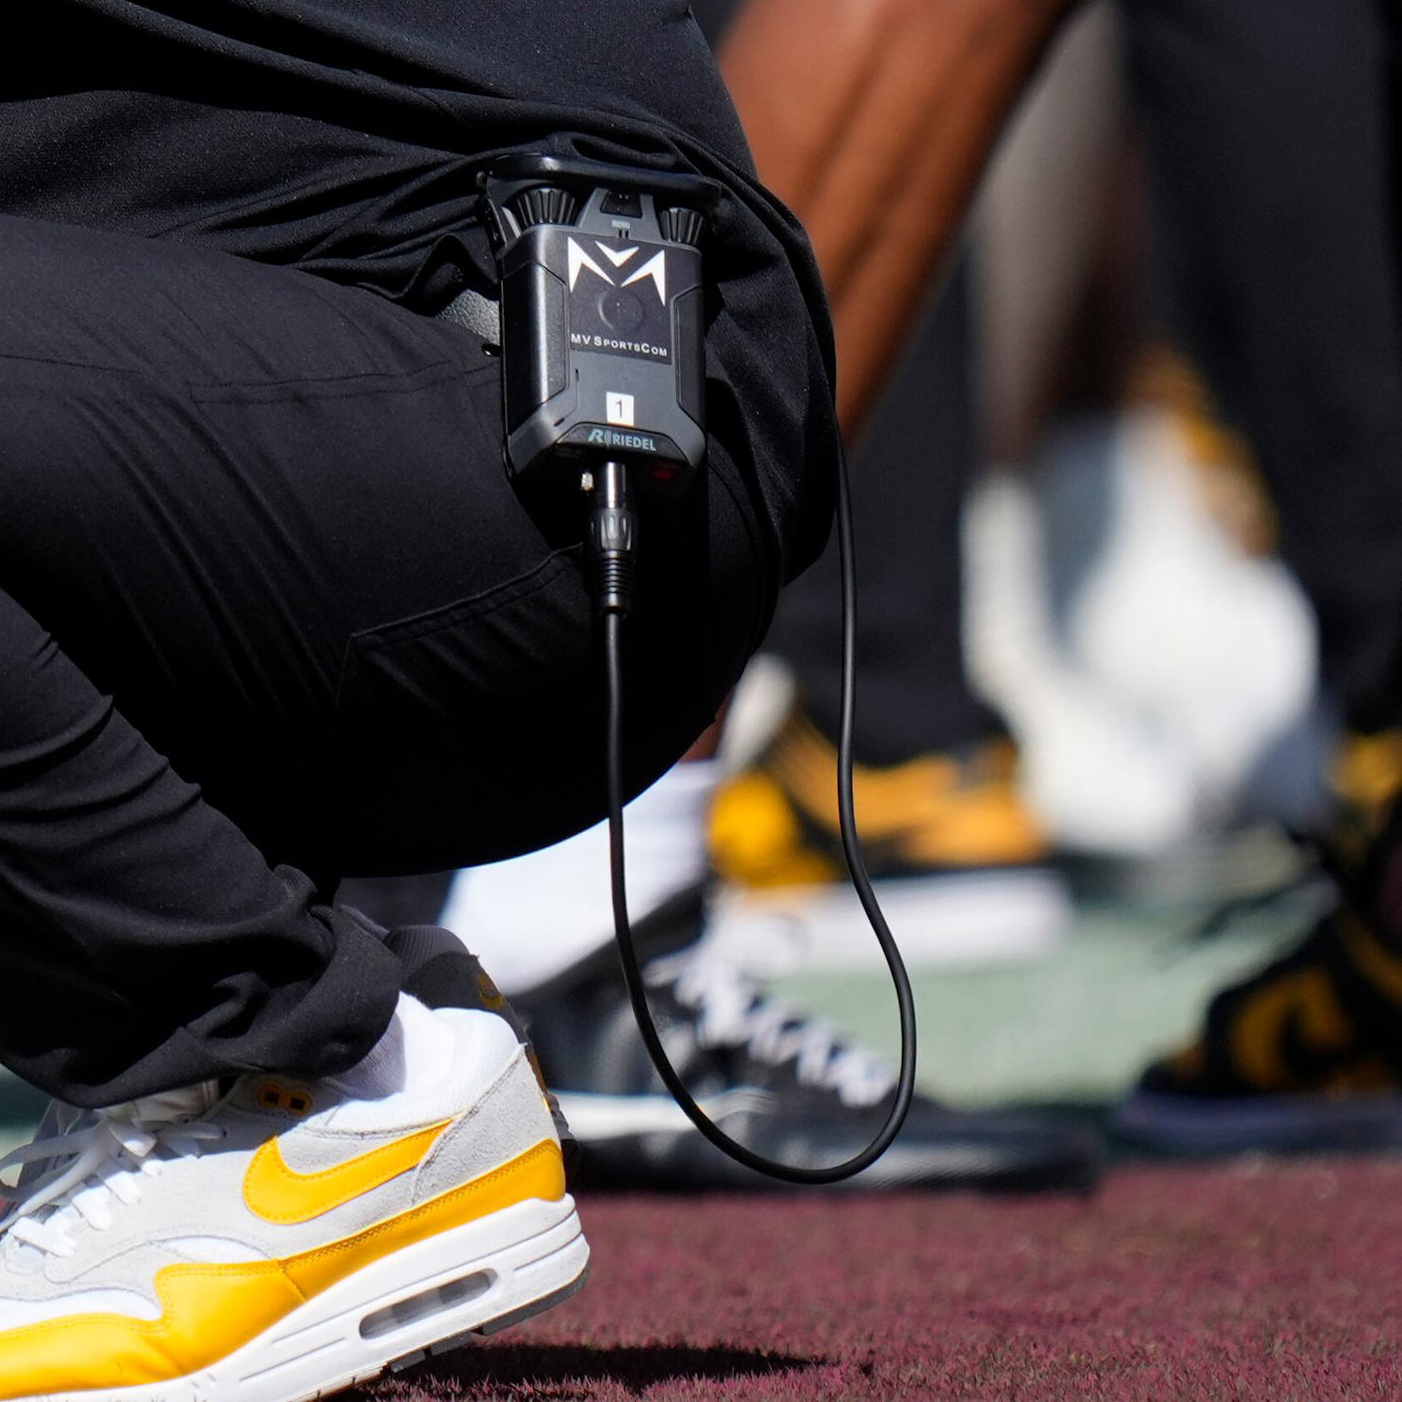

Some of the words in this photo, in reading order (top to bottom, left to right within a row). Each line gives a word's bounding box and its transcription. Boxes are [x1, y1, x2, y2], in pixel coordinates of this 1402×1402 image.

[571, 333, 591, 345] MV
[615, 399, 622, 418] 1
[612, 433, 657, 451] RIEDEL
